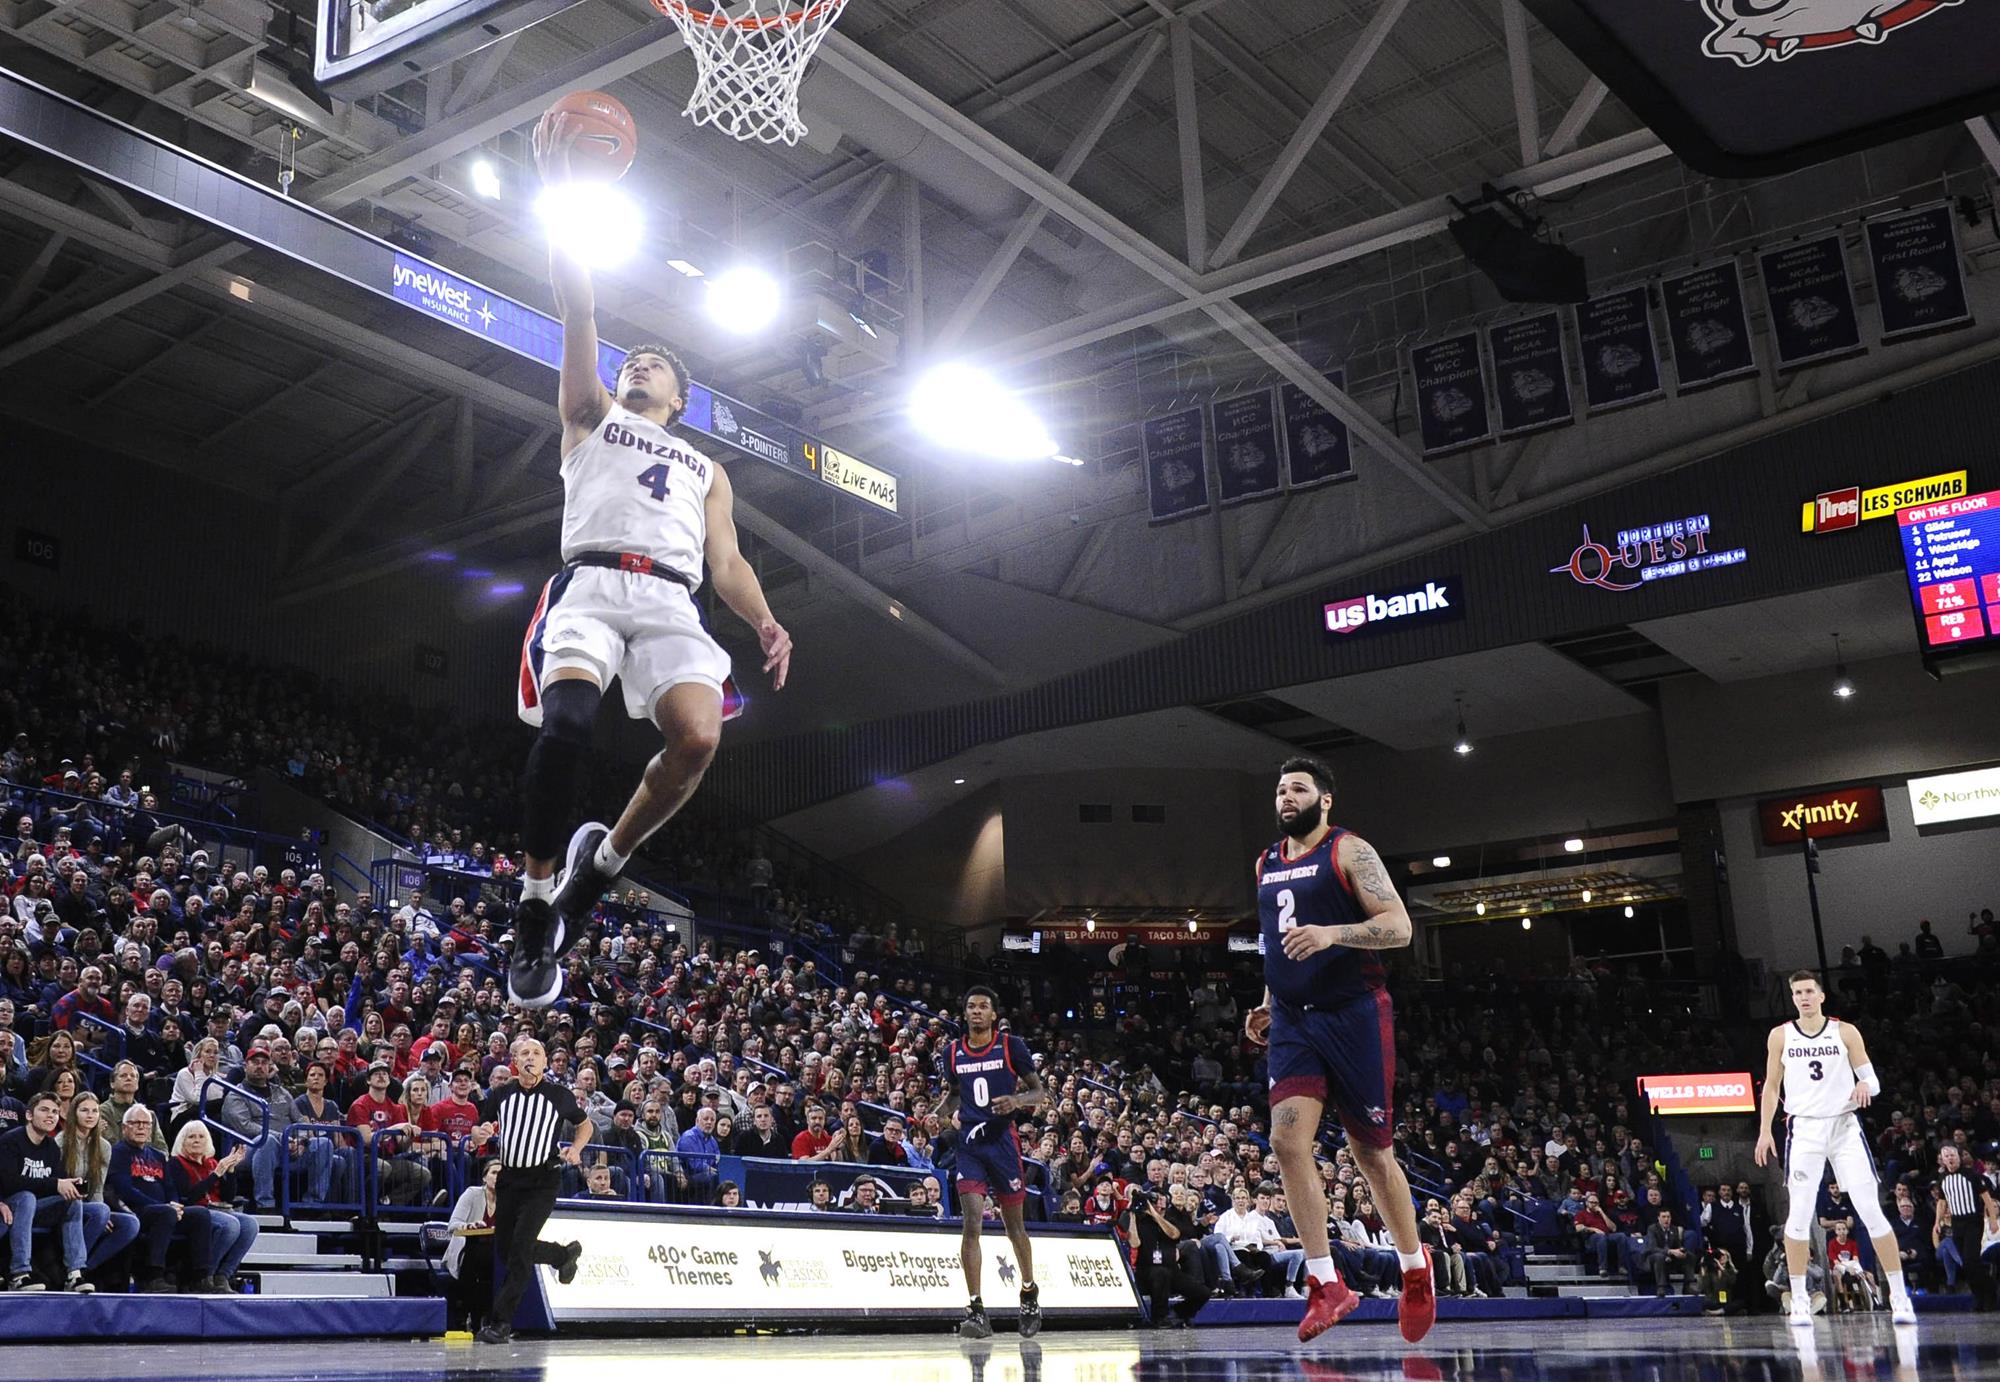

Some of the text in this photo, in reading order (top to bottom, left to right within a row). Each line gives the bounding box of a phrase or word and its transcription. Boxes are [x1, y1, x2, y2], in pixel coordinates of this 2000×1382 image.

[1881, 240, 1947, 264] First Round
[1896, 235, 1929, 249] NCAA
[421, 295, 470, 324] INSURANCE
[1433, 358, 1461, 372] WCC
[1419, 366, 1479, 389] Champions
[603, 422, 707, 486] GONZAGA
[740, 431, 816, 470] 3-POINTERS 4
[637, 463, 671, 502] 4
[869, 481, 895, 503] MÁS
[1864, 478, 1963, 513] LES SCHWAB
[1818, 496, 1858, 524] Tires
[1908, 497, 1988, 522] ON THE FLOOR
[1617, 514, 1711, 546] NORTHERN
[1911, 525, 1920, 536] 1
[28, 539, 56, 560] 106
[1550, 523, 1712, 592] QUEST
[1915, 547, 1924, 558] 4
[1641, 548, 1748, 582] RESORT & CASINO
[1915, 559, 1930, 571] 11
[1917, 571, 1932, 583] 22
[1938, 583, 1956, 595] FG
[1935, 595, 1965, 610] 71%
[1940, 612, 1966, 626] REB
[285, 851, 302, 864] 105
[405, 875, 420, 886] 106
[1290, 864, 1319, 880] MERCY
[1276, 888, 1297, 933] 2
[1043, 930, 1119, 940] BAED POTATO
[1148, 931, 1210, 940] TACO SALAD
[1788, 1045, 1840, 1058] GONZAGA
[1808, 1060, 1824, 1081] 3
[973, 1077, 990, 1108] 0
[1644, 1083, 1746, 1100] WELLS FARGO
[1700, 1147, 1713, 1159] EXIT
[691, 1245, 738, 1266] Game
[842, 1249, 962, 1273] Biggest Progressi
[1067, 1254, 1113, 1274] Highest
[664, 1265, 733, 1286] Themes
[889, 1269, 950, 1292] Jackpots
[1070, 1271, 1095, 1287] Max
[1095, 1271, 1122, 1287] Bets
